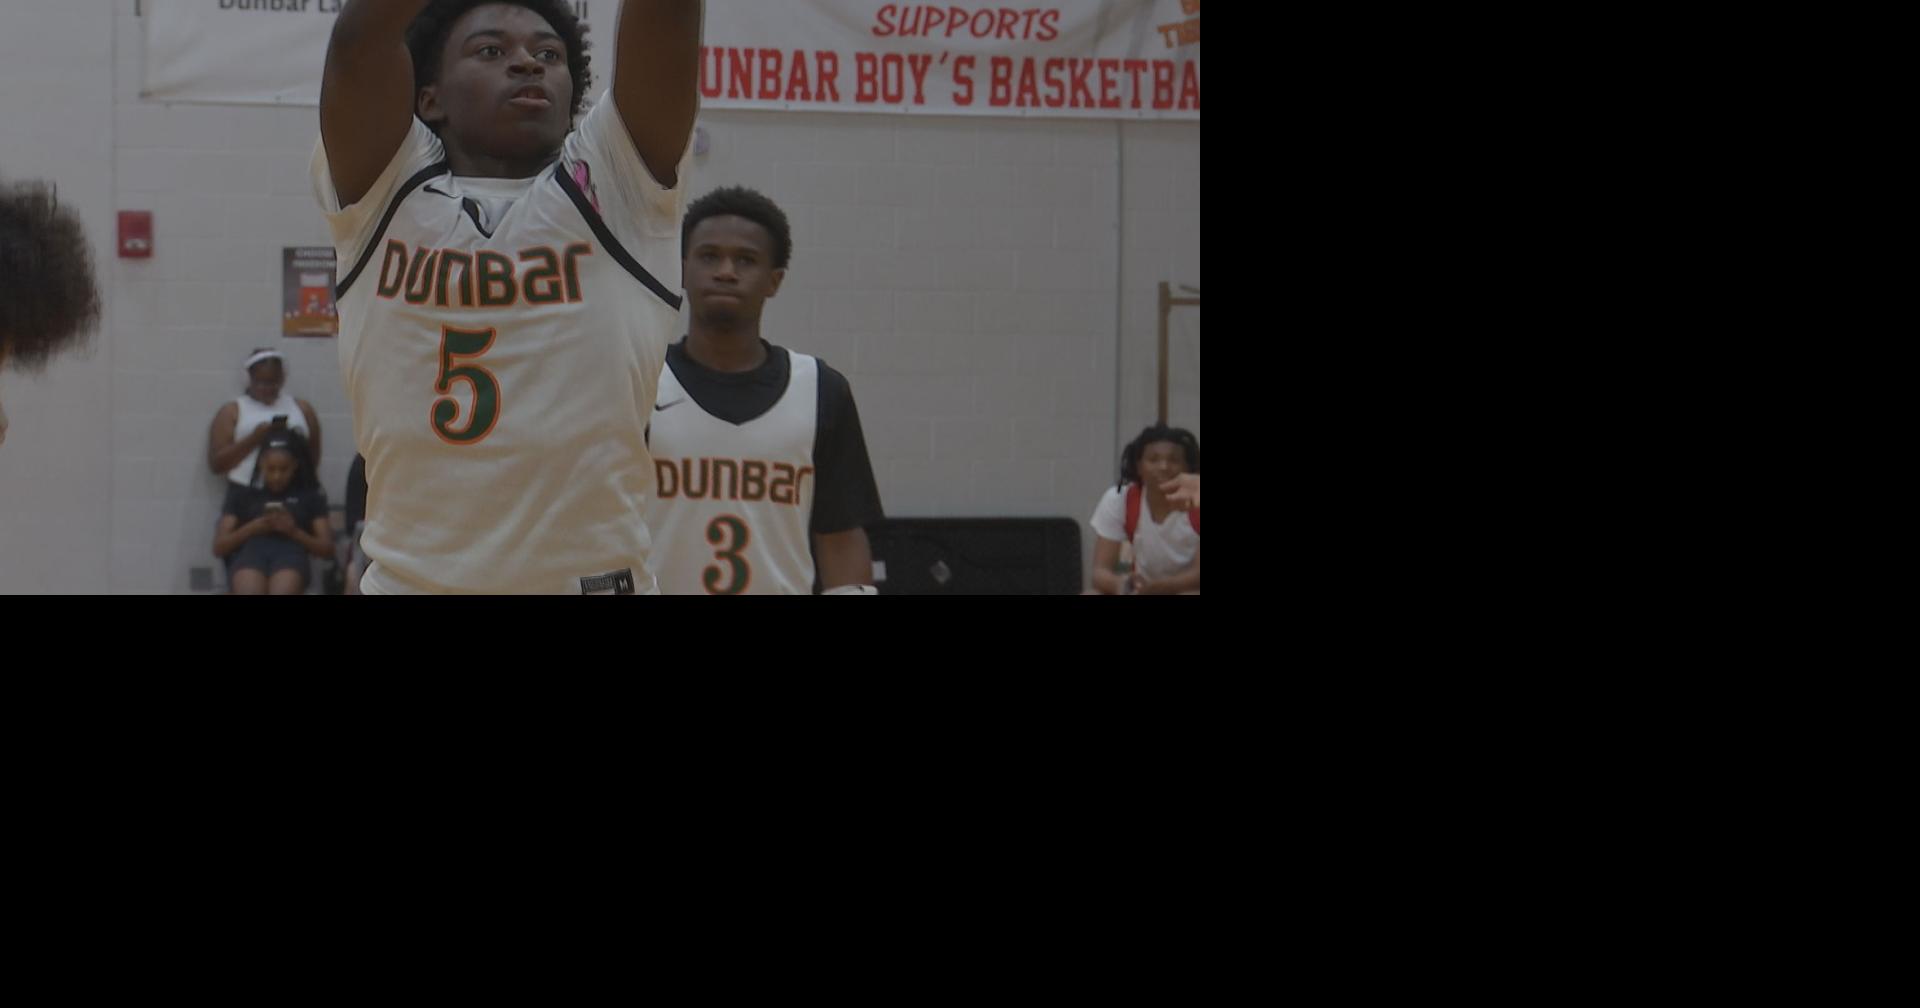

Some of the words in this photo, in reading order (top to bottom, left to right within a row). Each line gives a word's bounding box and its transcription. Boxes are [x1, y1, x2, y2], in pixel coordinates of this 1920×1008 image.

[871, 4, 1060, 41] SUPPORTS
[855, 51, 976, 106] BOY'S
[430, 320, 502, 446] 5
[702, 513, 751, 595] 3
